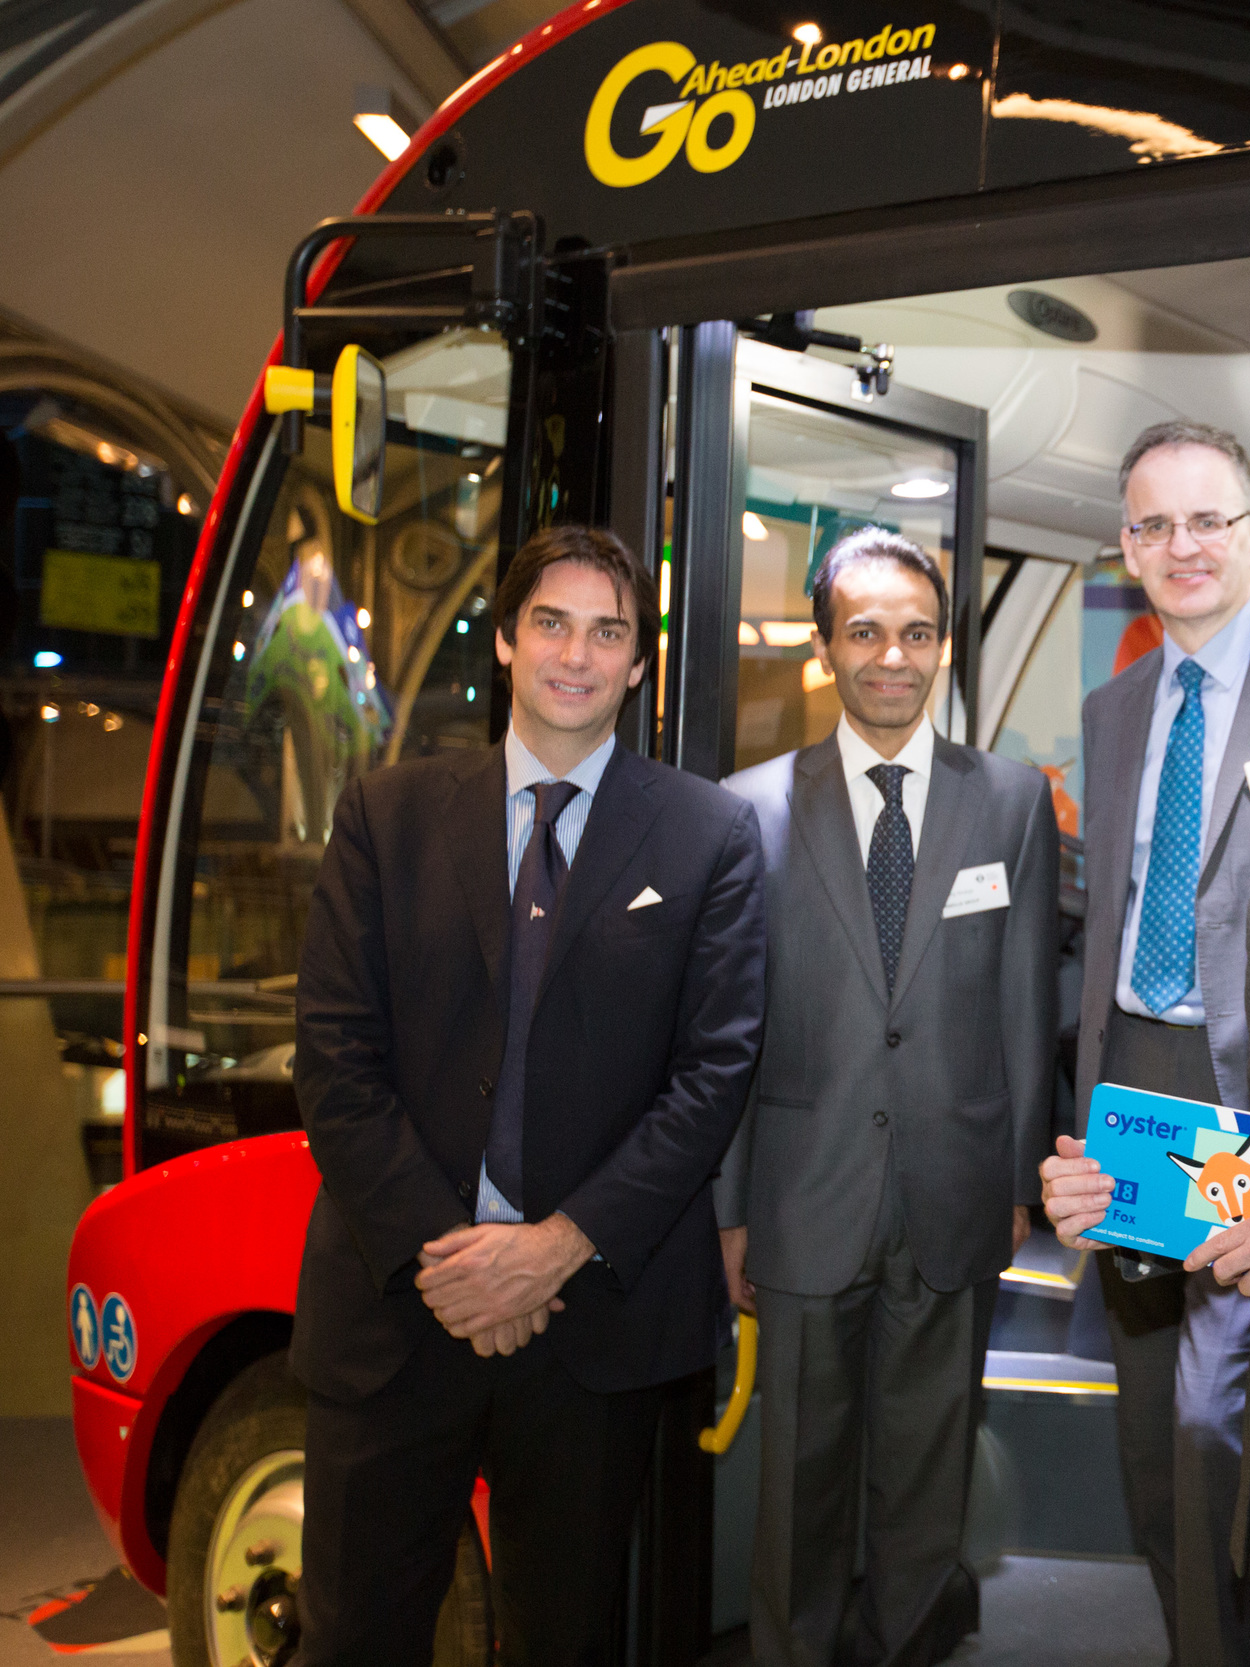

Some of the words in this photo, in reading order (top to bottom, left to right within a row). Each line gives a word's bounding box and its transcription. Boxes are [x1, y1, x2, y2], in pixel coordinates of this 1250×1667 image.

[678, 23, 937, 99] Ahead-London
[763, 72, 844, 110] LONDON
[846, 55, 933, 94] GENERAL
[584, 41, 756, 188] Go
[1105, 1111, 1182, 1141] oyster
[1112, 1208, 1136, 1225] Fox
